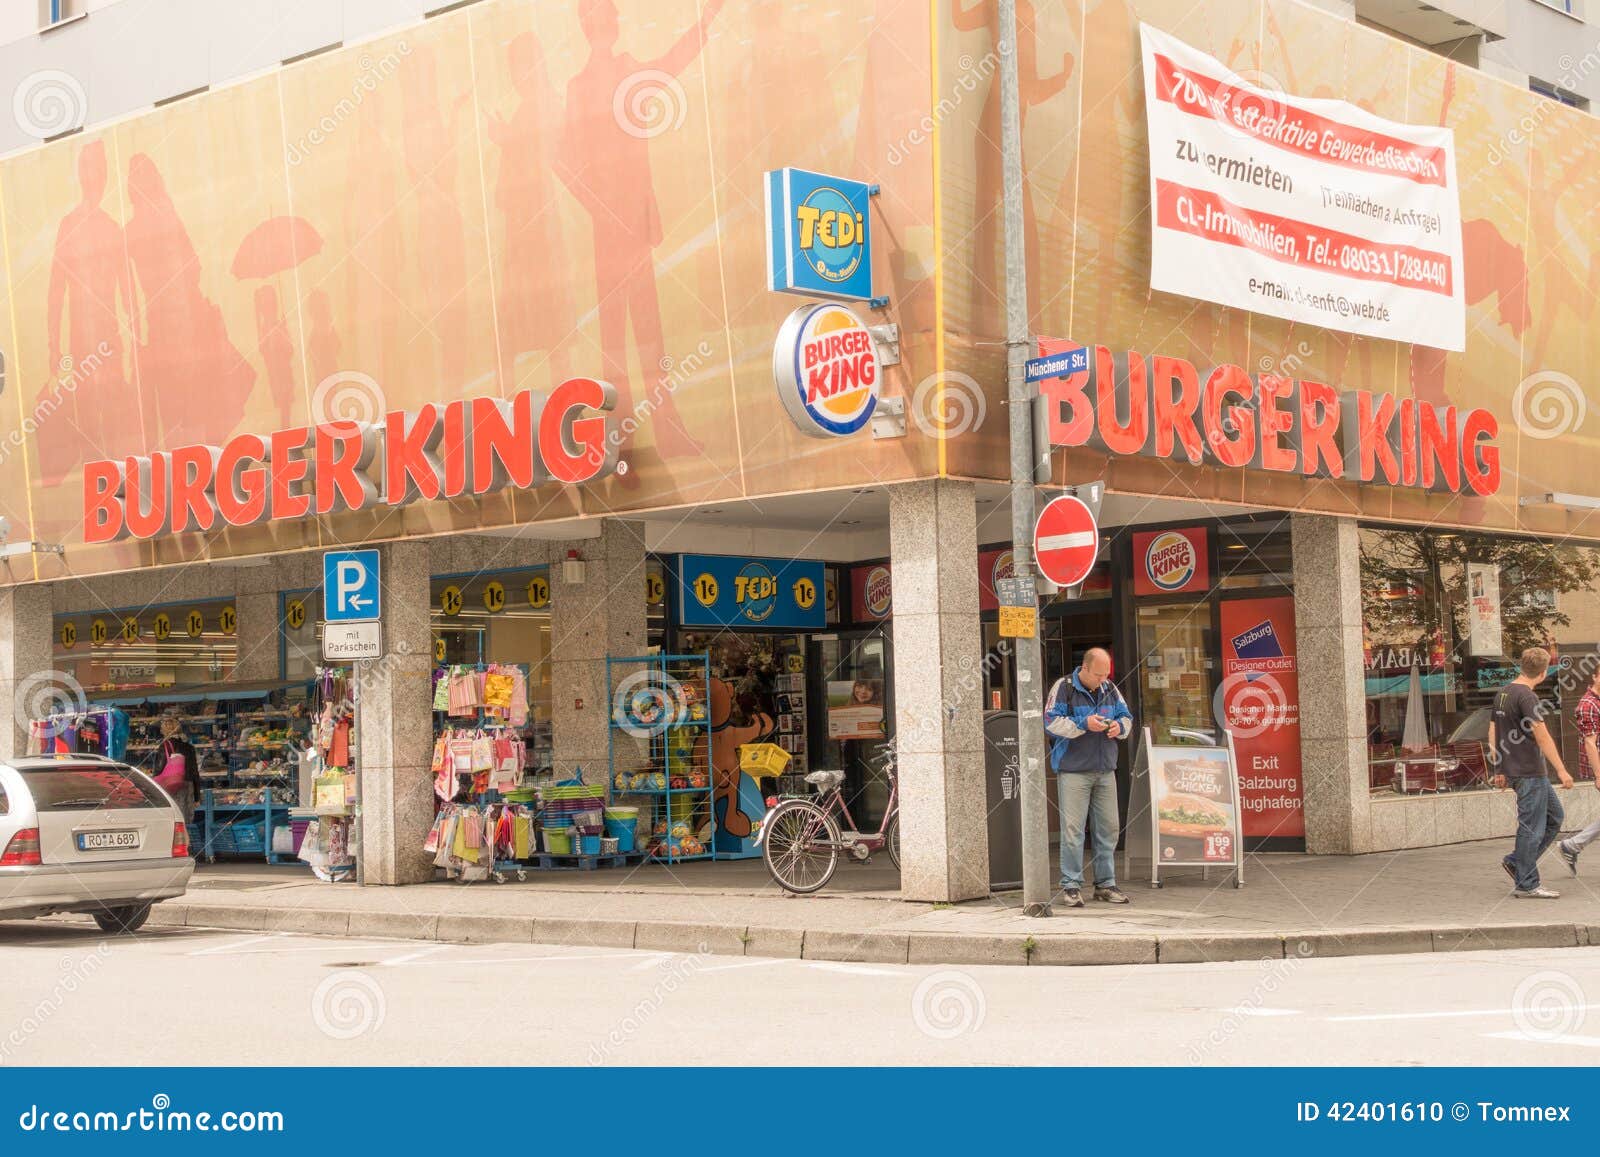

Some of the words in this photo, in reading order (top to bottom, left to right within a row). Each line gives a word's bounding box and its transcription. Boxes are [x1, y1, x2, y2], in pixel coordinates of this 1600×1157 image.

[1171, 71, 1207, 107] 700
[1232, 105, 1318, 150] attraktive
[1176, 139, 1199, 163] zu
[1203, 151, 1293, 194] ermieten
[1177, 196, 1300, 262] CL-Immobilien,
[1306, 235, 1337, 267] Tel.:
[1340, 245, 1446, 287] 08031/288440
[805, 331, 871, 369] BURGER
[1028, 359, 1068, 378] Münchener
[1072, 354, 1086, 368] Str.
[806, 353, 875, 404] KING
[1038, 336, 1345, 478] BURGER
[1358, 391, 1502, 496] KING
[83, 421, 379, 543] BURGER
[387, 378, 608, 505] KING
[1151, 542, 1189, 566] BURGER
[1153, 552, 1190, 579] KING
[996, 562, 1014, 581] BURG
[337, 560, 367, 612] P
[869, 583, 891, 608] KING
[328, 642, 377, 651] Parkschein
[346, 631, 360, 639] mit
[1235, 625, 1272, 649] Salzburg
[1230, 660, 1266, 671] Designer
[1266, 659, 1292, 669] Outlet
[1229, 705, 1265, 715] Designer
[1267, 704, 1298, 713] Marken
[1262, 716, 1299, 727] günstiger
[1252, 755, 1279, 769] Exit
[1174, 780, 1221, 795] CHICKEN
[1181, 771, 1216, 784] LONG
[1238, 775, 1297, 792] Salzburg
[88, 835, 102, 846] RO
[117, 833, 135, 845] 689
